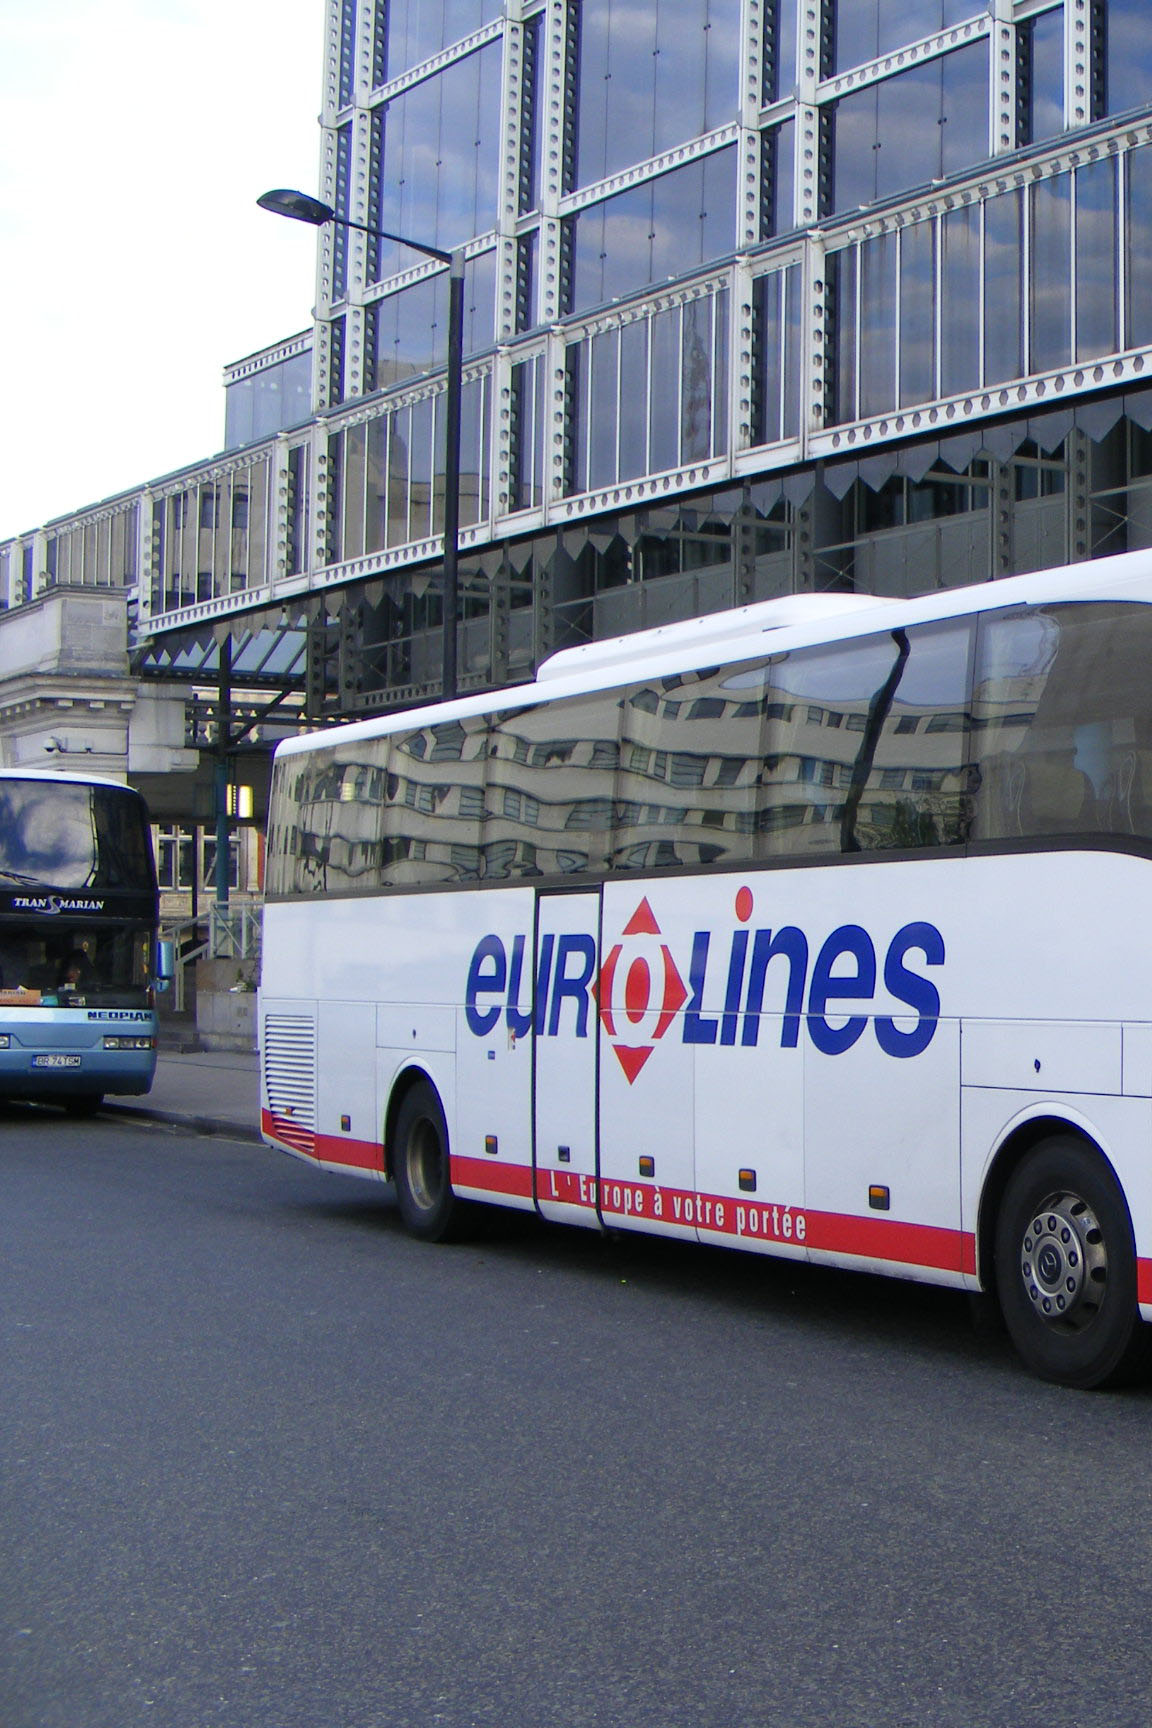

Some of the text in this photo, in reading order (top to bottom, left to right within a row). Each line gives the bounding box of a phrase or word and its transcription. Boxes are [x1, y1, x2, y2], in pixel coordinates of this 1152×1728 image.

[654, 1186, 662, 1215] à
[673, 1194, 725, 1227] votre
[736, 1206, 807, 1240] portée
